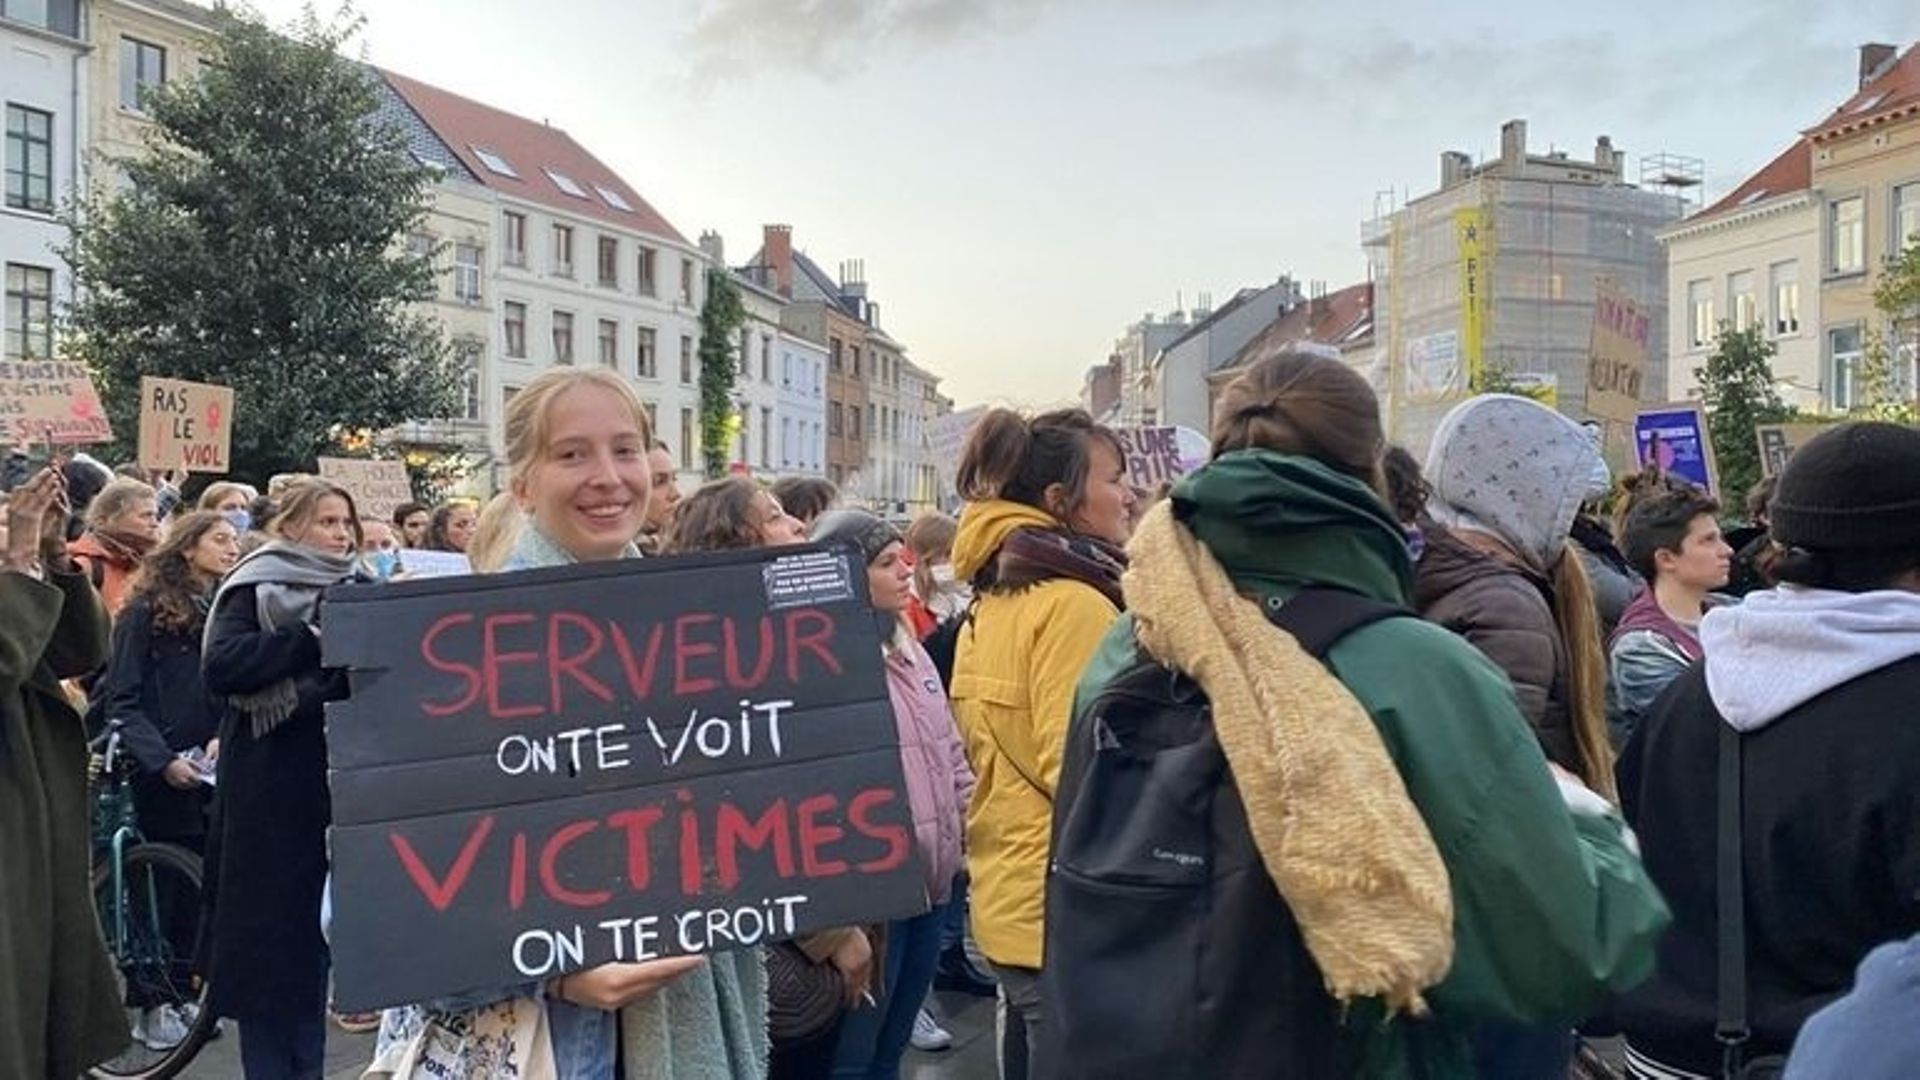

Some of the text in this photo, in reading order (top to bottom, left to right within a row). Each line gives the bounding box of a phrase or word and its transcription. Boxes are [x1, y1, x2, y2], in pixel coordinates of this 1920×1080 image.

[153, 387, 188, 414] RAS
[173, 418, 195, 439] LE
[183, 443, 223, 467] VIOL
[421, 608, 843, 718] SERVEUR
[512, 926, 585, 977] ON
[600, 915, 660, 963] TE
